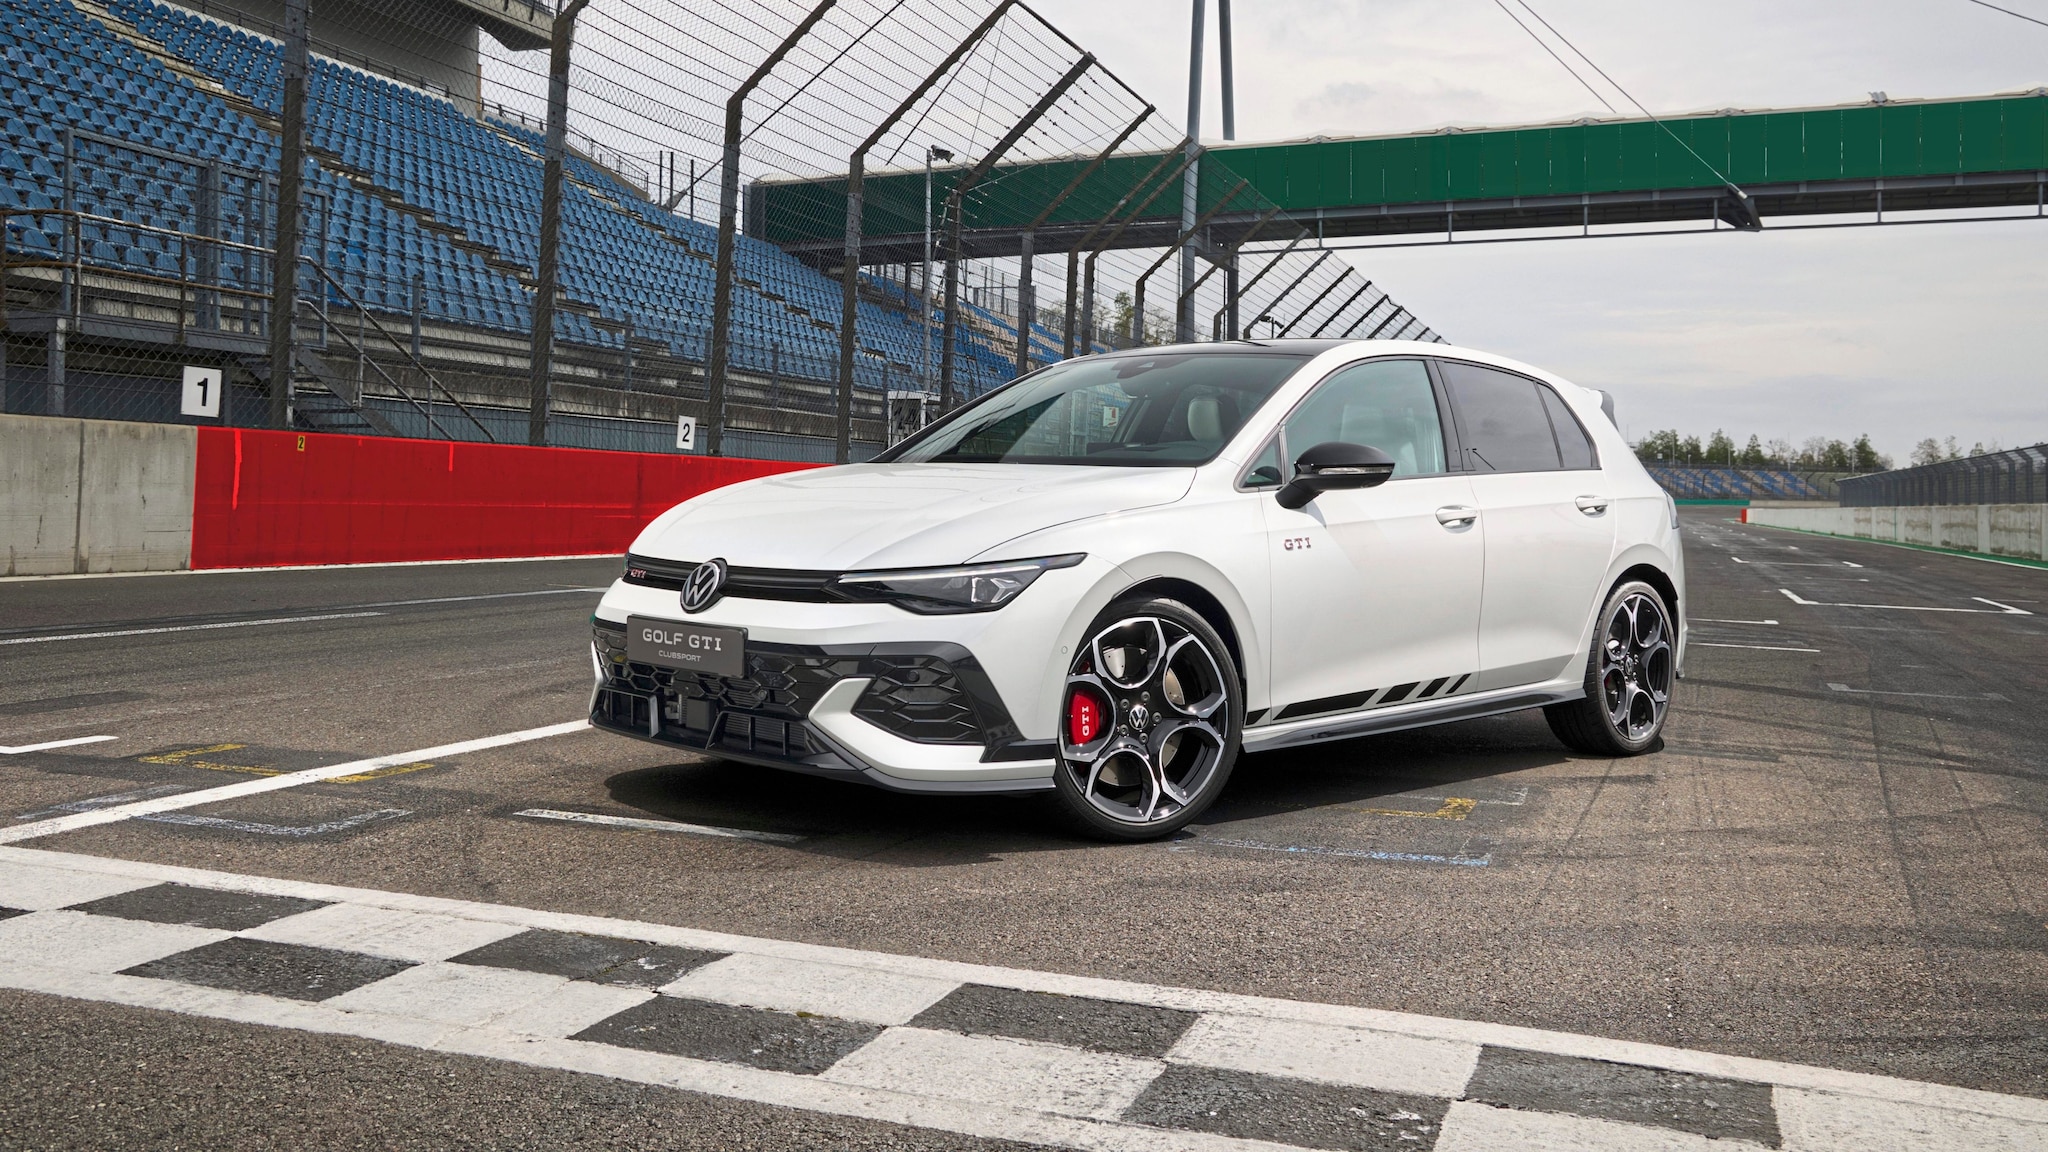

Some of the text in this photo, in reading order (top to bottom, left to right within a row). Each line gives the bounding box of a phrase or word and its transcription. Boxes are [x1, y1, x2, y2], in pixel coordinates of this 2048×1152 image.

[197, 377, 208, 407] 1
[298, 436, 304, 450] 2
[682, 422, 691, 443] 2
[1284, 537, 1311, 551] GTI
[630, 569, 646, 579] GTI
[682, 561, 719, 610] VW
[642, 628, 722, 651] GOLF GTI
[658, 649, 701, 662] CLUBSPORT
[1081, 706, 1090, 736] GTI
[1129, 705, 1149, 730] VW
